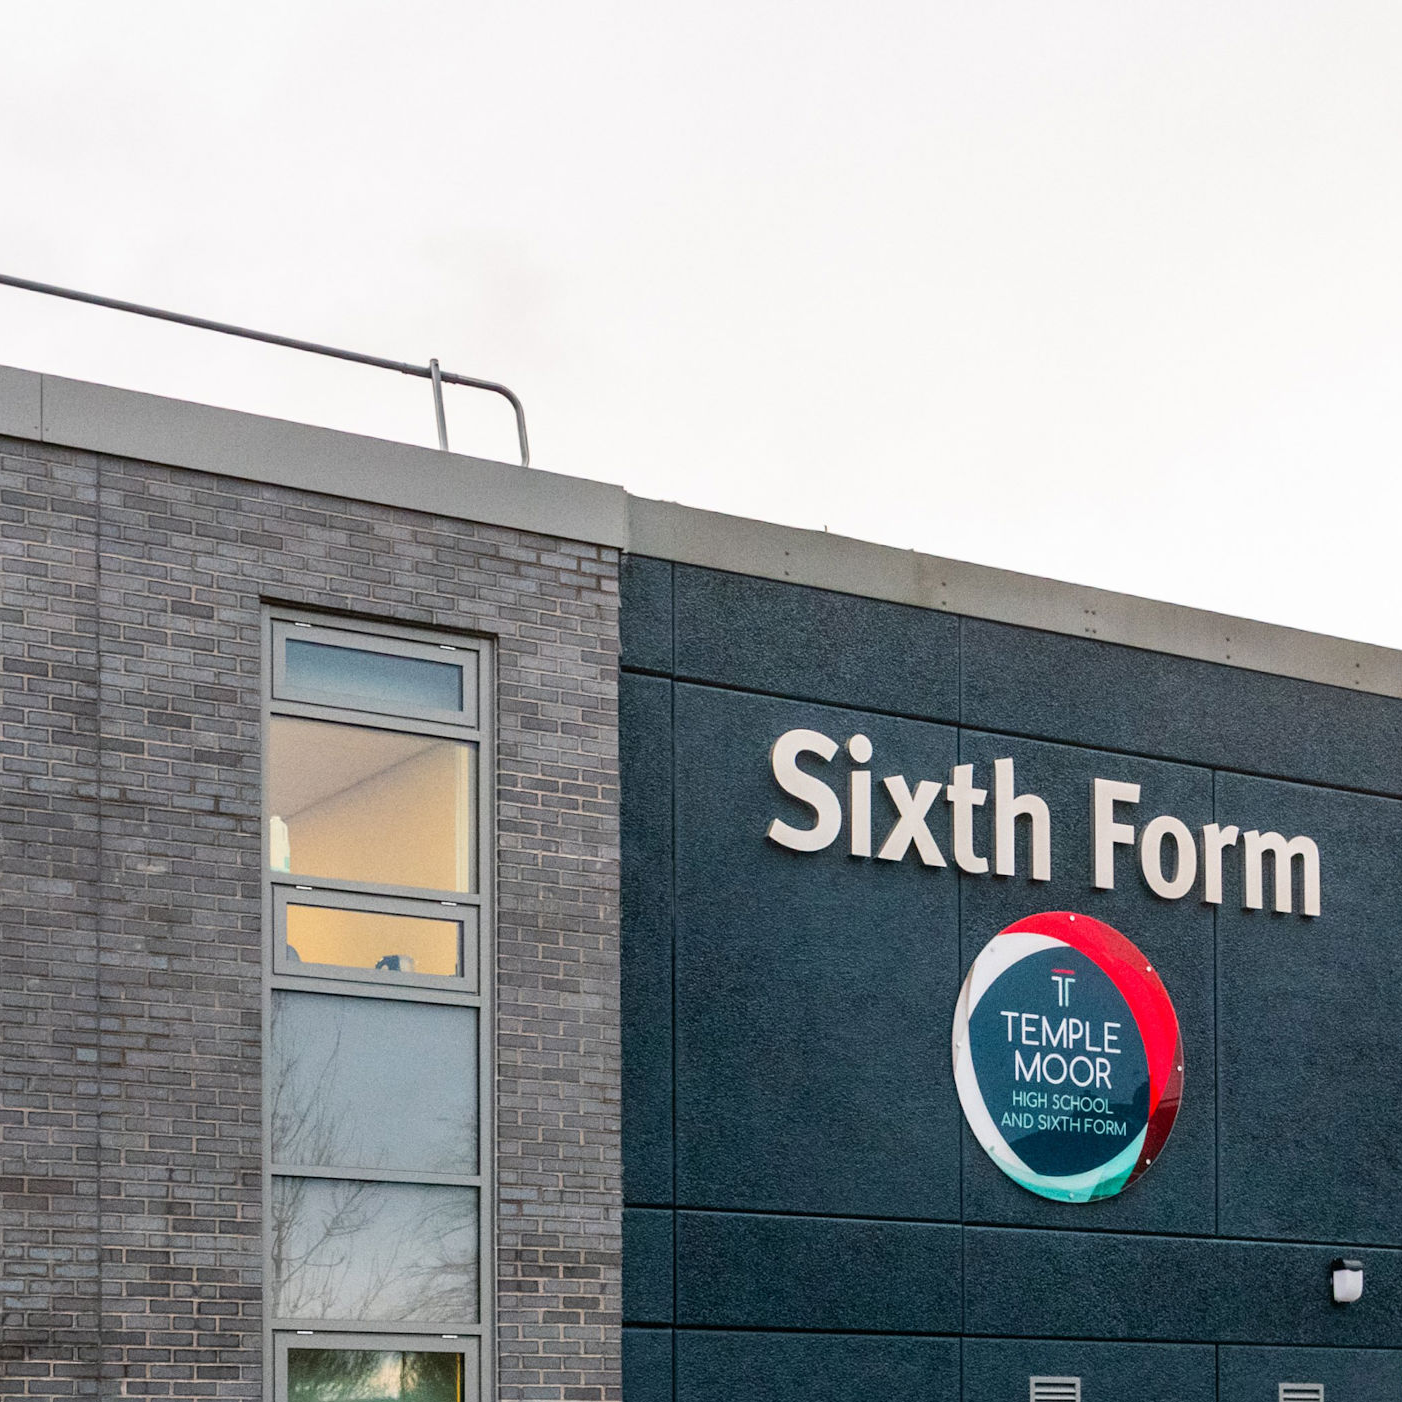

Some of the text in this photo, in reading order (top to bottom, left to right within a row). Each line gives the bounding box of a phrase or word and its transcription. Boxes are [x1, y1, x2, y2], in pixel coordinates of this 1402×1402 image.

[766, 728, 1322, 917] Sixth Form
[1000, 1010, 1122, 1054] TEMPLE
[1014, 1049, 1112, 1090] MOOR
[1012, 1089, 1115, 1115] HIGH SCHOOL
[1000, 1111, 1127, 1137] AND SIXTH FORM
